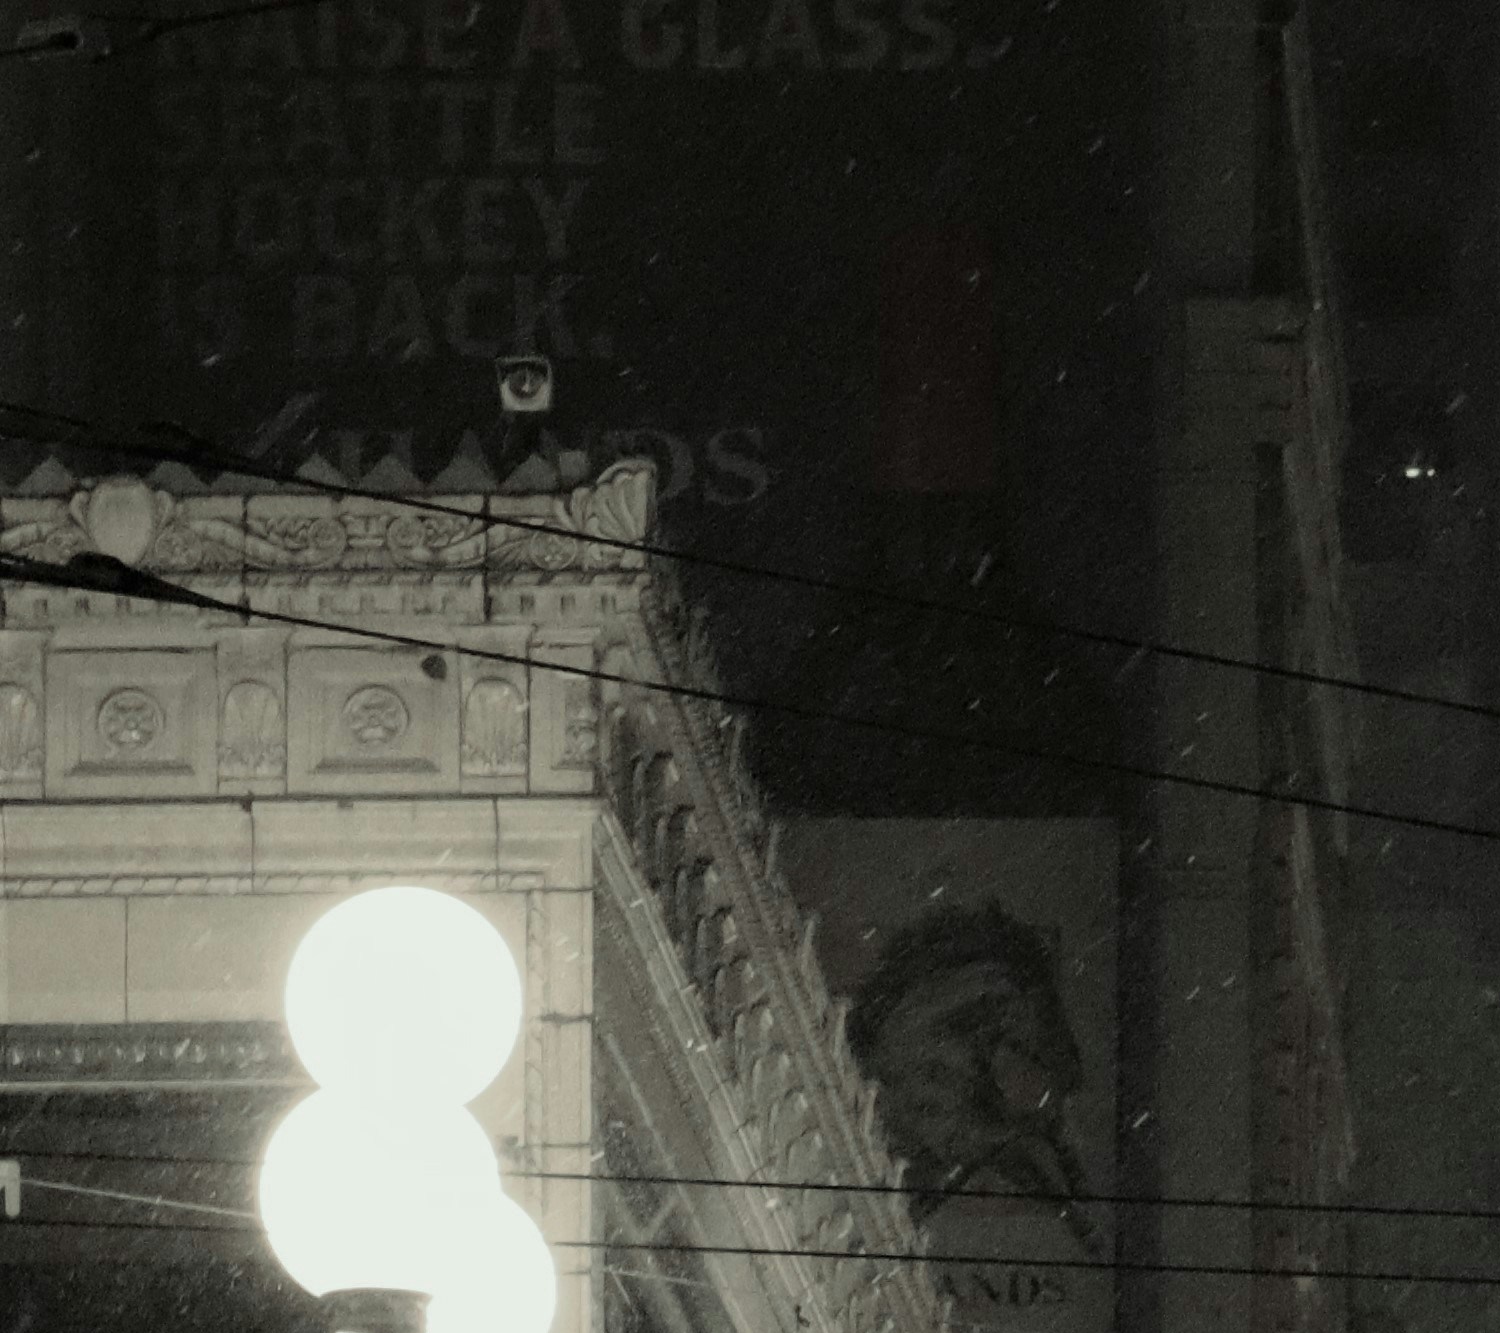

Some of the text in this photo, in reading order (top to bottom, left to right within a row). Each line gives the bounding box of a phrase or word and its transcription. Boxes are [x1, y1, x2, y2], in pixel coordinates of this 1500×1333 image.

[509, 0, 585, 70] A
[152, 80, 606, 166] SEATTLE
[155, 176, 592, 265] HOCKEY
